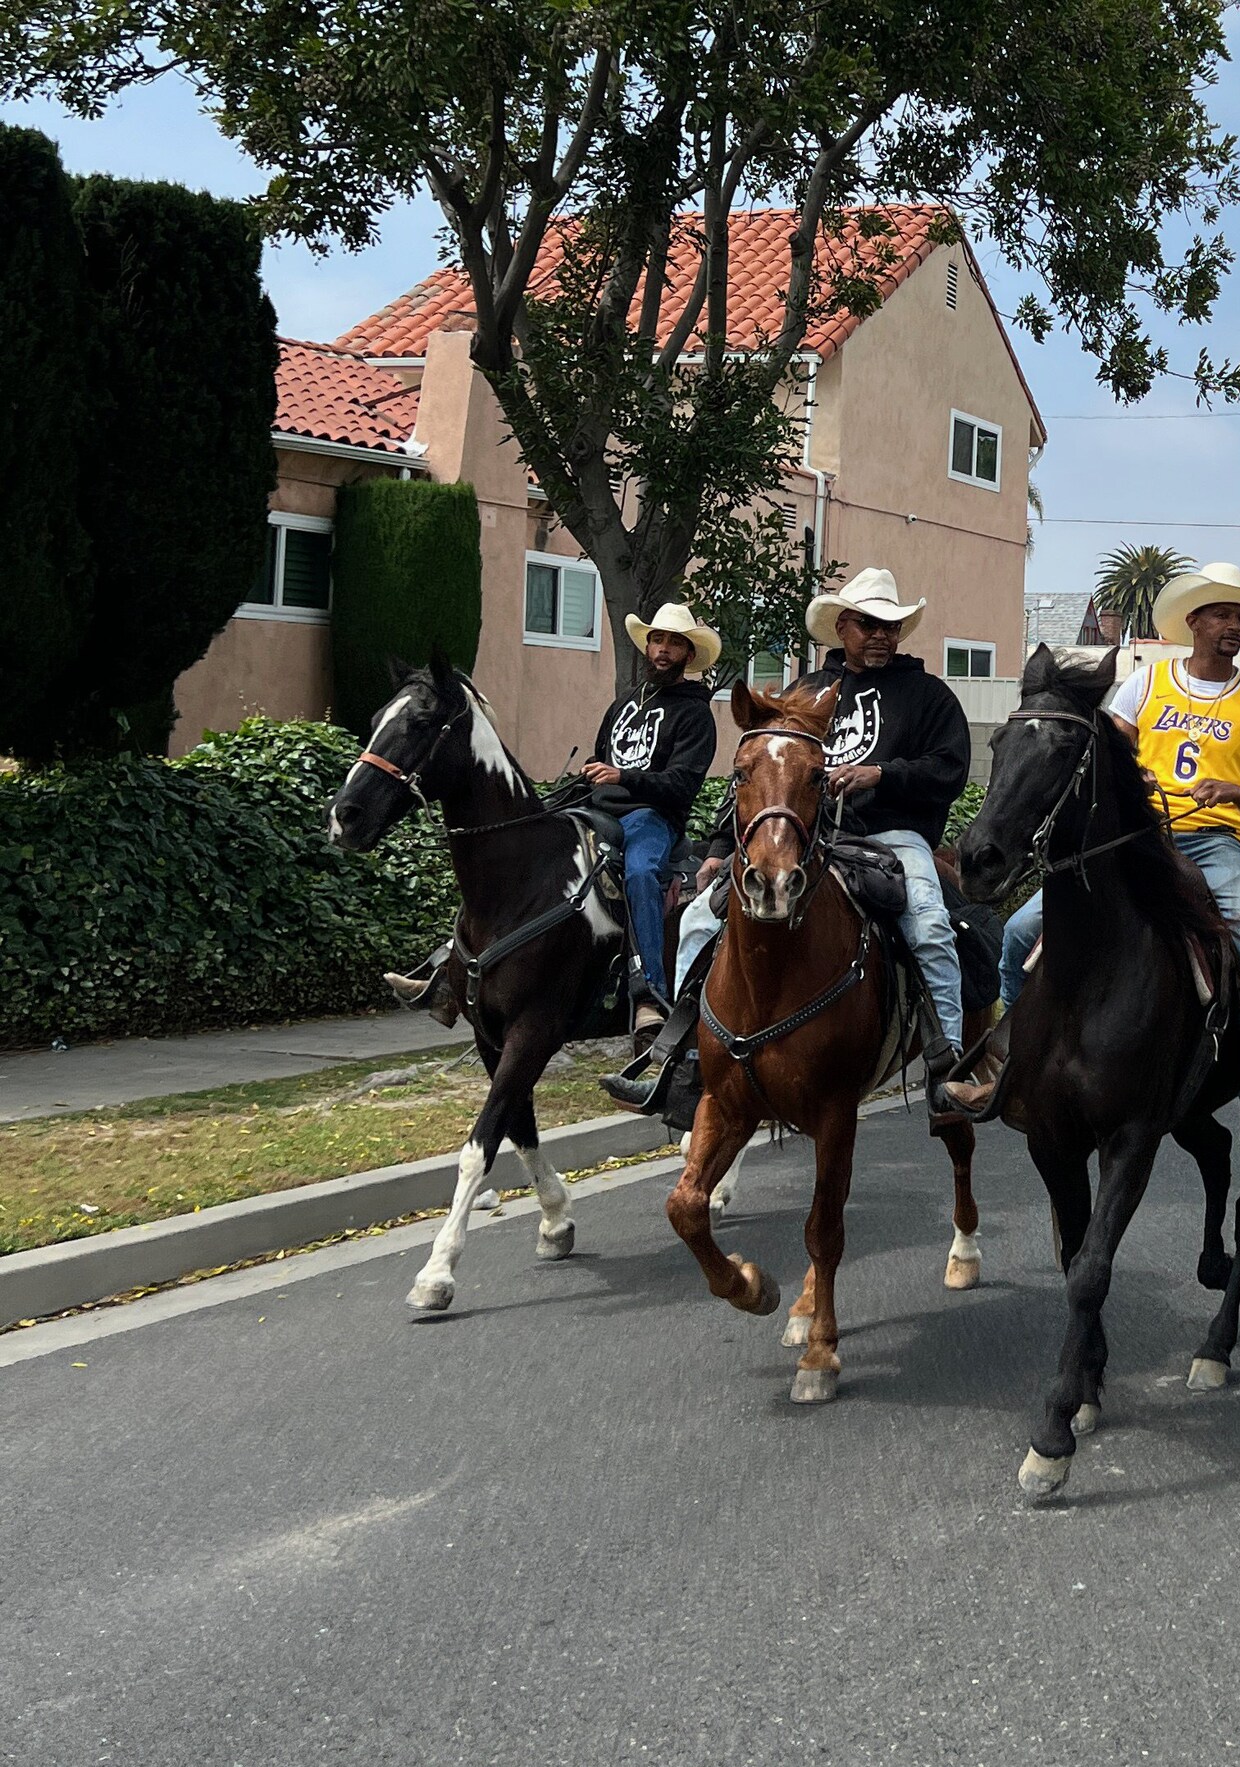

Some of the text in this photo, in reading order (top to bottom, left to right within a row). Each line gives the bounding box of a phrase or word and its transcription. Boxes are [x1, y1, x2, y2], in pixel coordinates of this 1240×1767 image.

[1152, 705, 1232, 740] LAKERS
[831, 745, 867, 765] Saddles
[1175, 741, 1200, 779] 6
